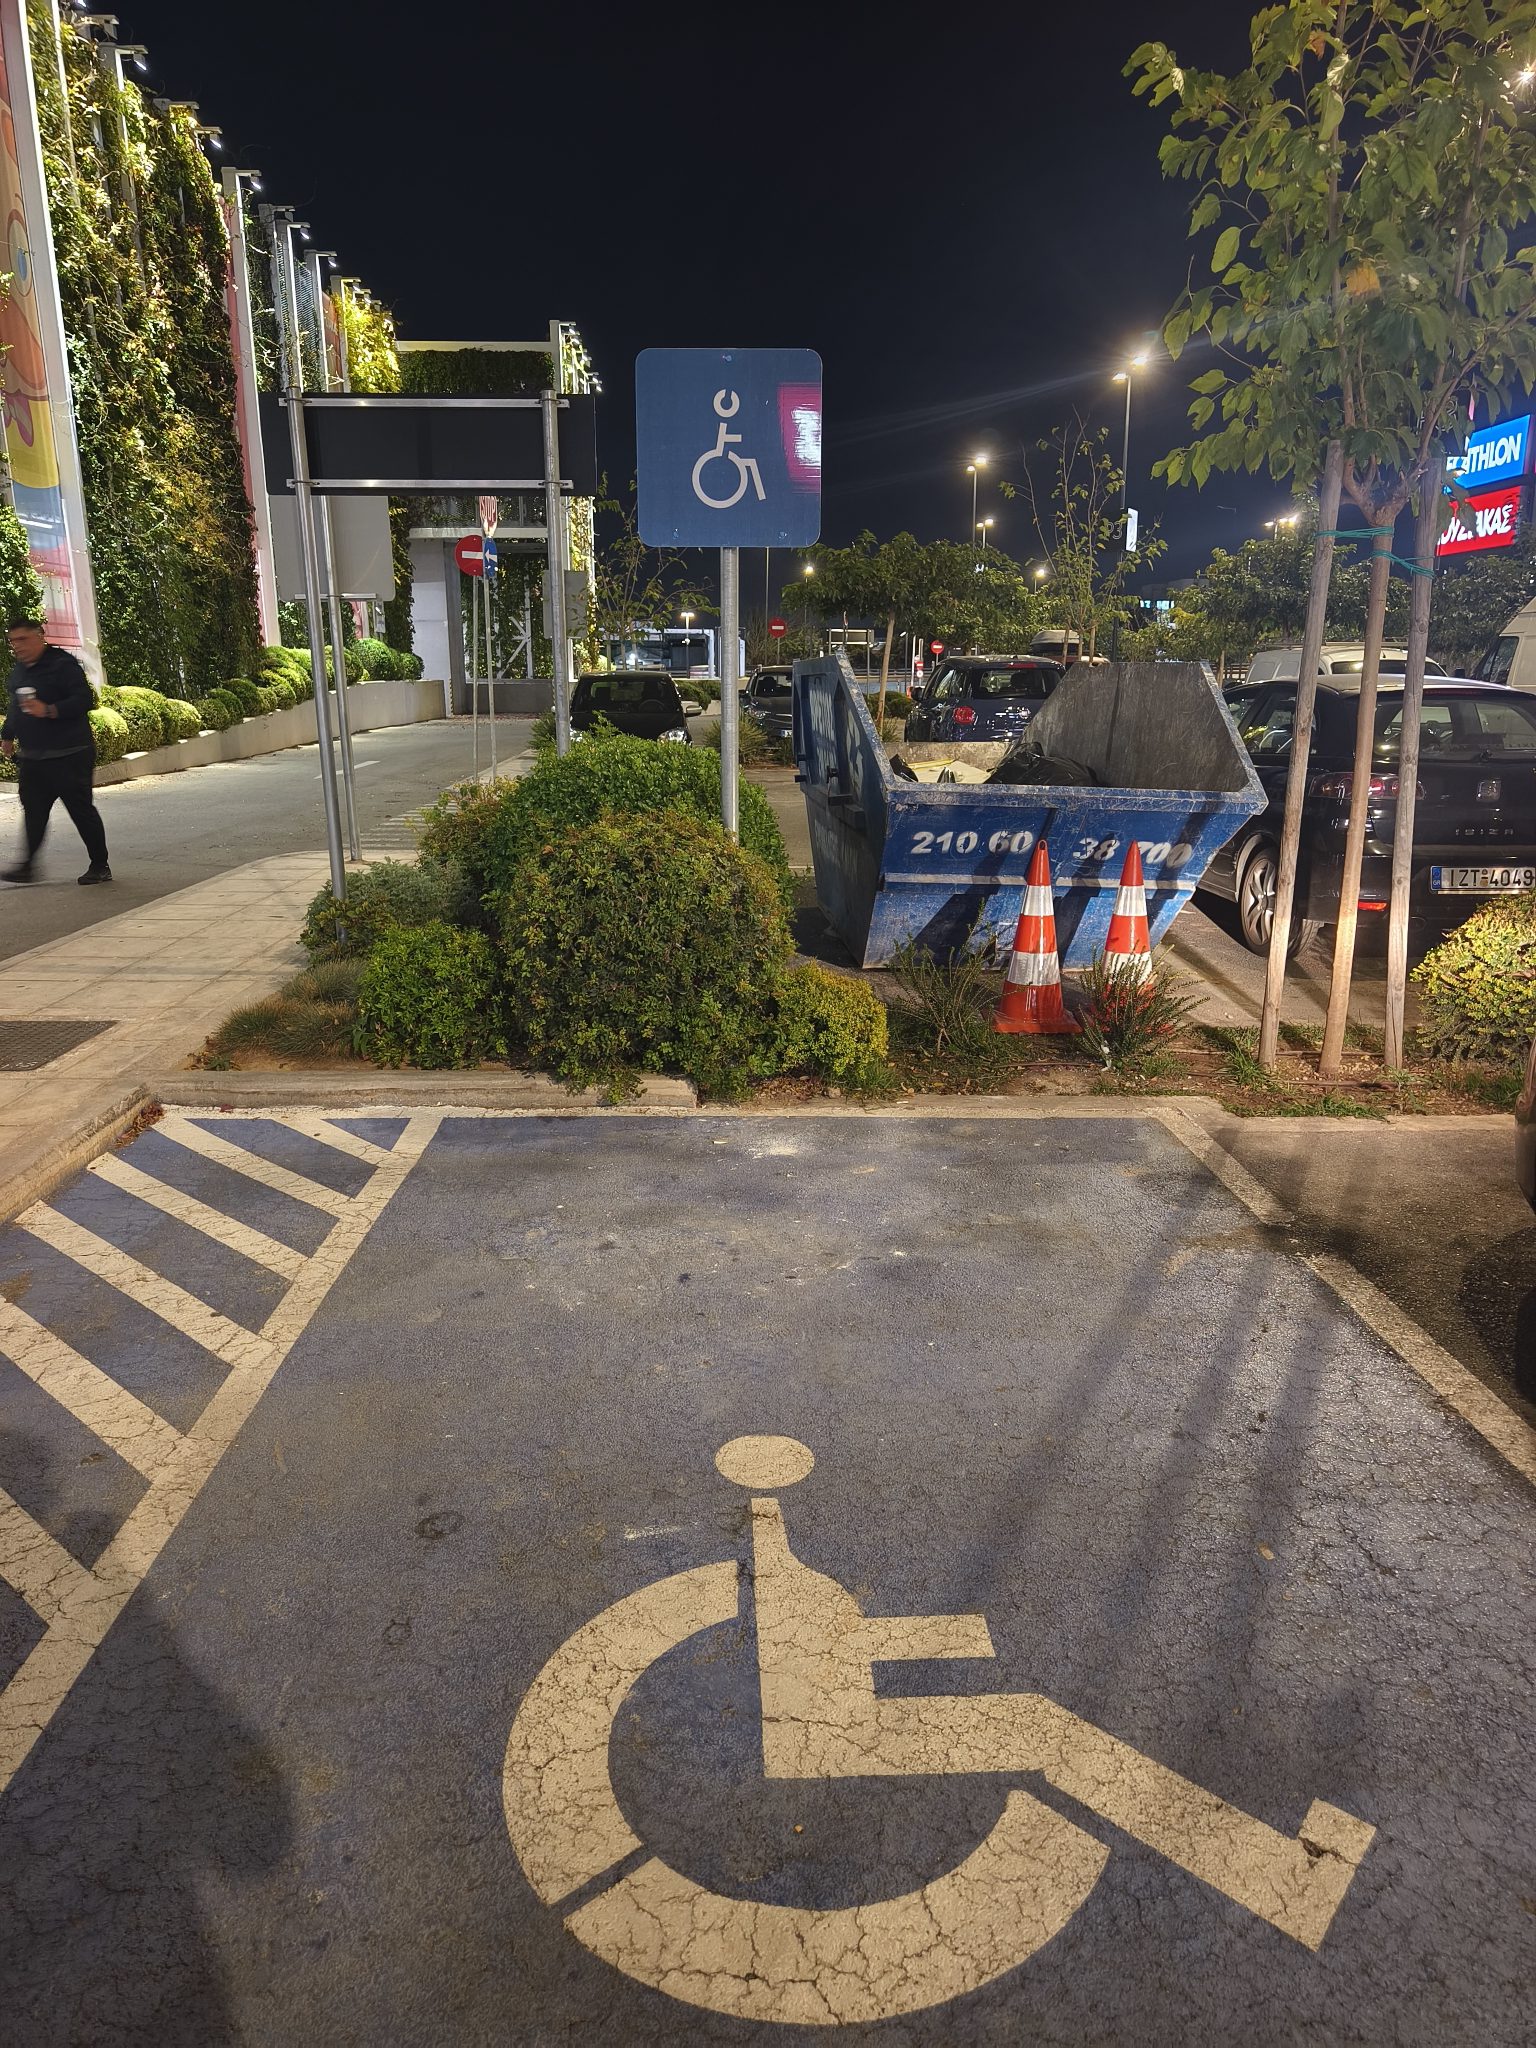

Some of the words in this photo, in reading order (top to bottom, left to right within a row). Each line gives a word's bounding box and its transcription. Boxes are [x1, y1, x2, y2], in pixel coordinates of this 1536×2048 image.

[910, 830, 978, 855] 210
[987, 829, 1034, 855] 60
[1072, 837, 1121, 861] 38
[1137, 841, 1193, 868] 700
